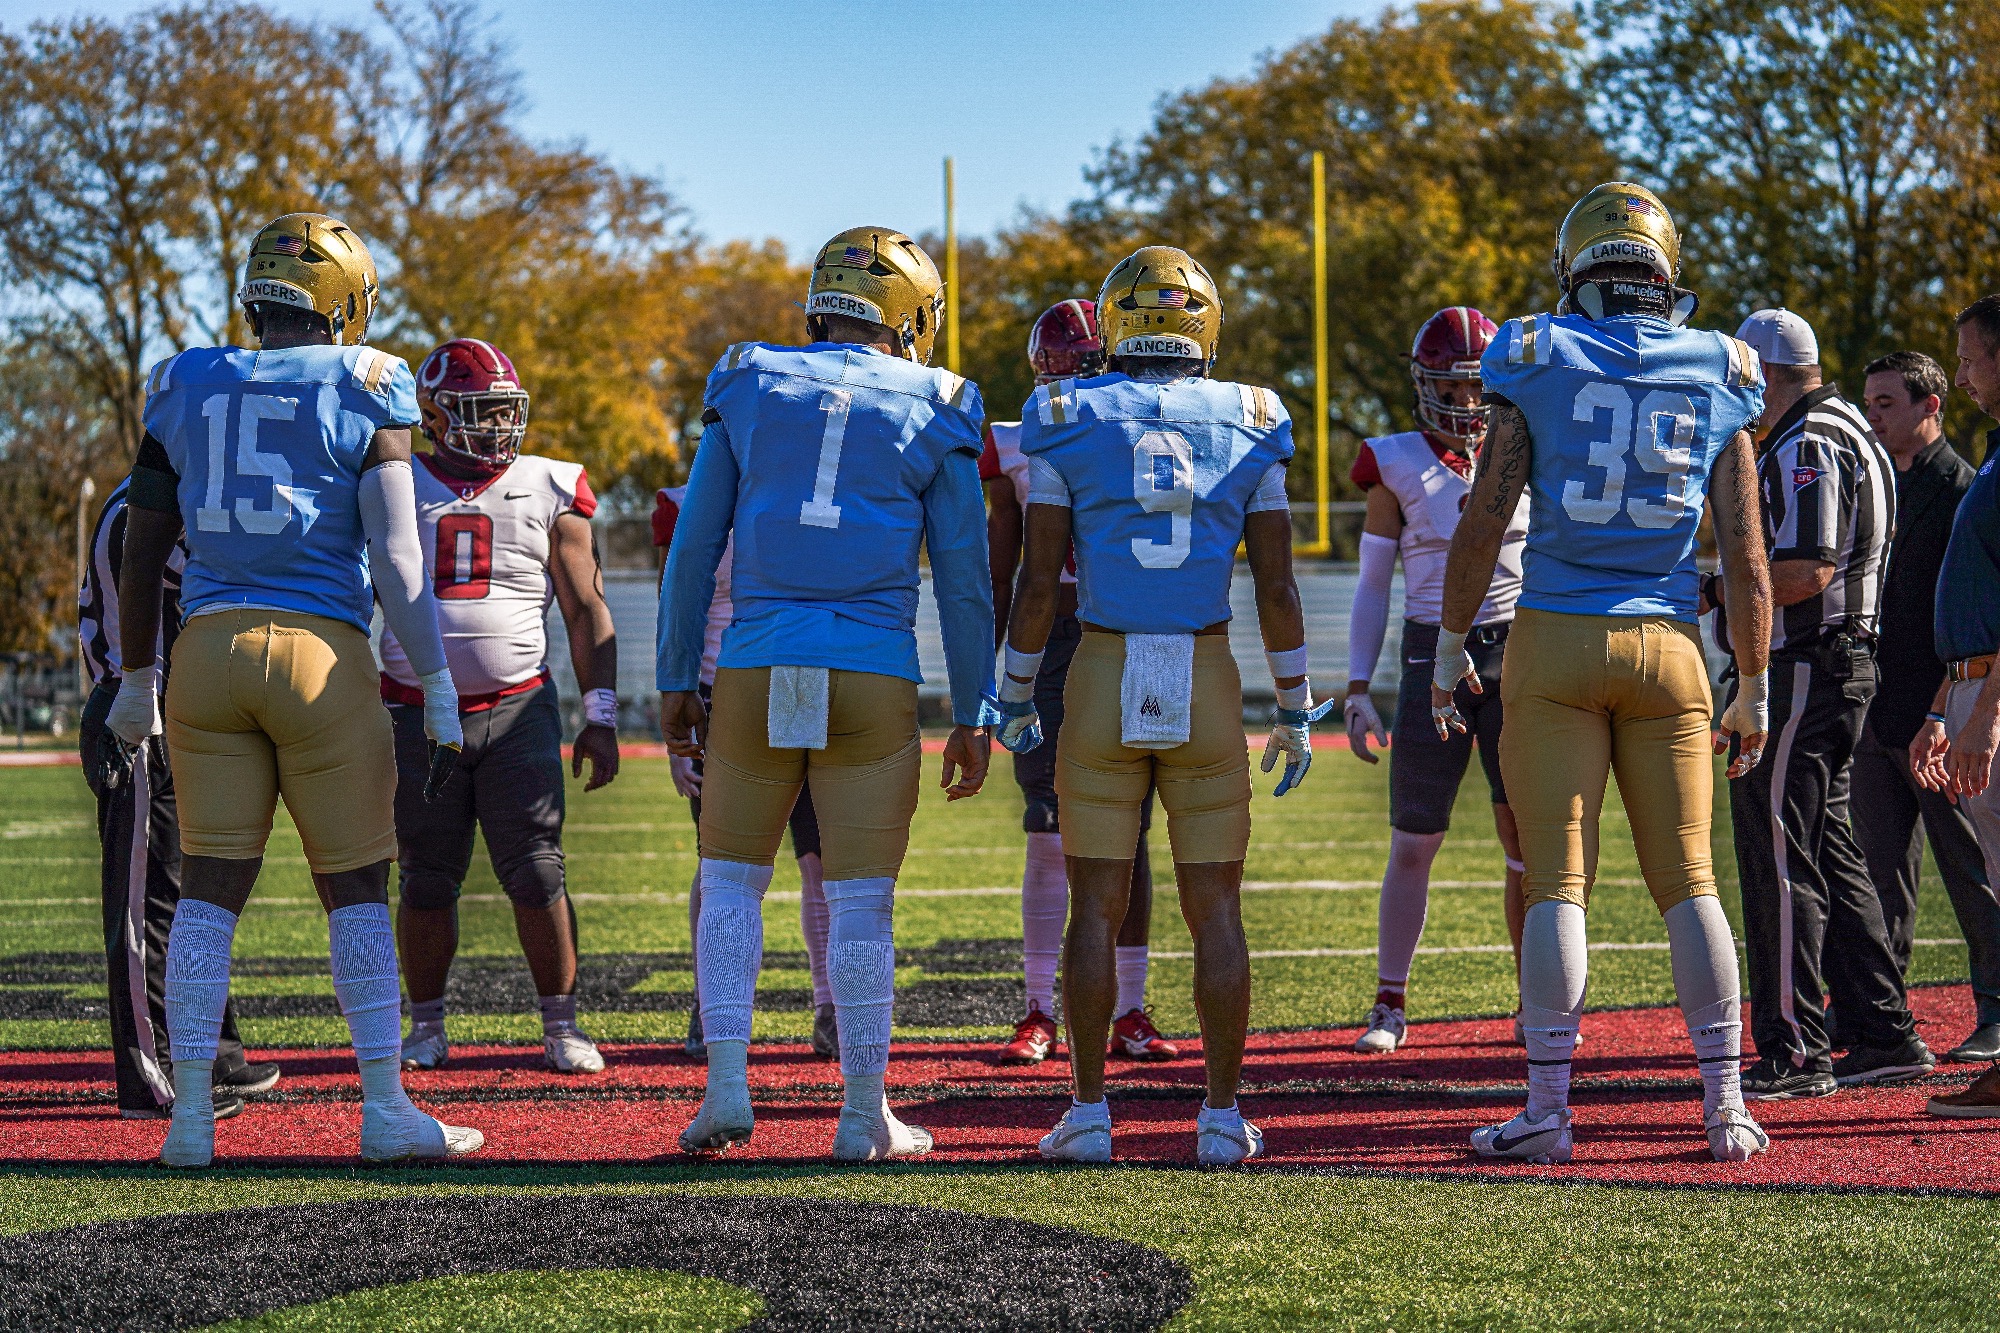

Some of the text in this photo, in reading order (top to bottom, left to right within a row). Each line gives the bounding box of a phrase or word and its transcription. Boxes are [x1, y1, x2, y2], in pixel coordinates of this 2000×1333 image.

[1605, 212, 1618, 222] 39
[1591, 243, 1657, 262] LANCERS
[256, 260, 265, 271] 15
[1619, 283, 1666, 299] Mueller
[810, 295, 866, 315] LANCERS
[1143, 314, 1150, 325] 9
[1126, 340, 1191, 356] LANCERS
[196, 393, 299, 535] 15
[799, 389, 854, 529] 1
[1561, 381, 1696, 529] 39
[1131, 430, 1194, 569] 9
[433, 513, 494, 600] 0
